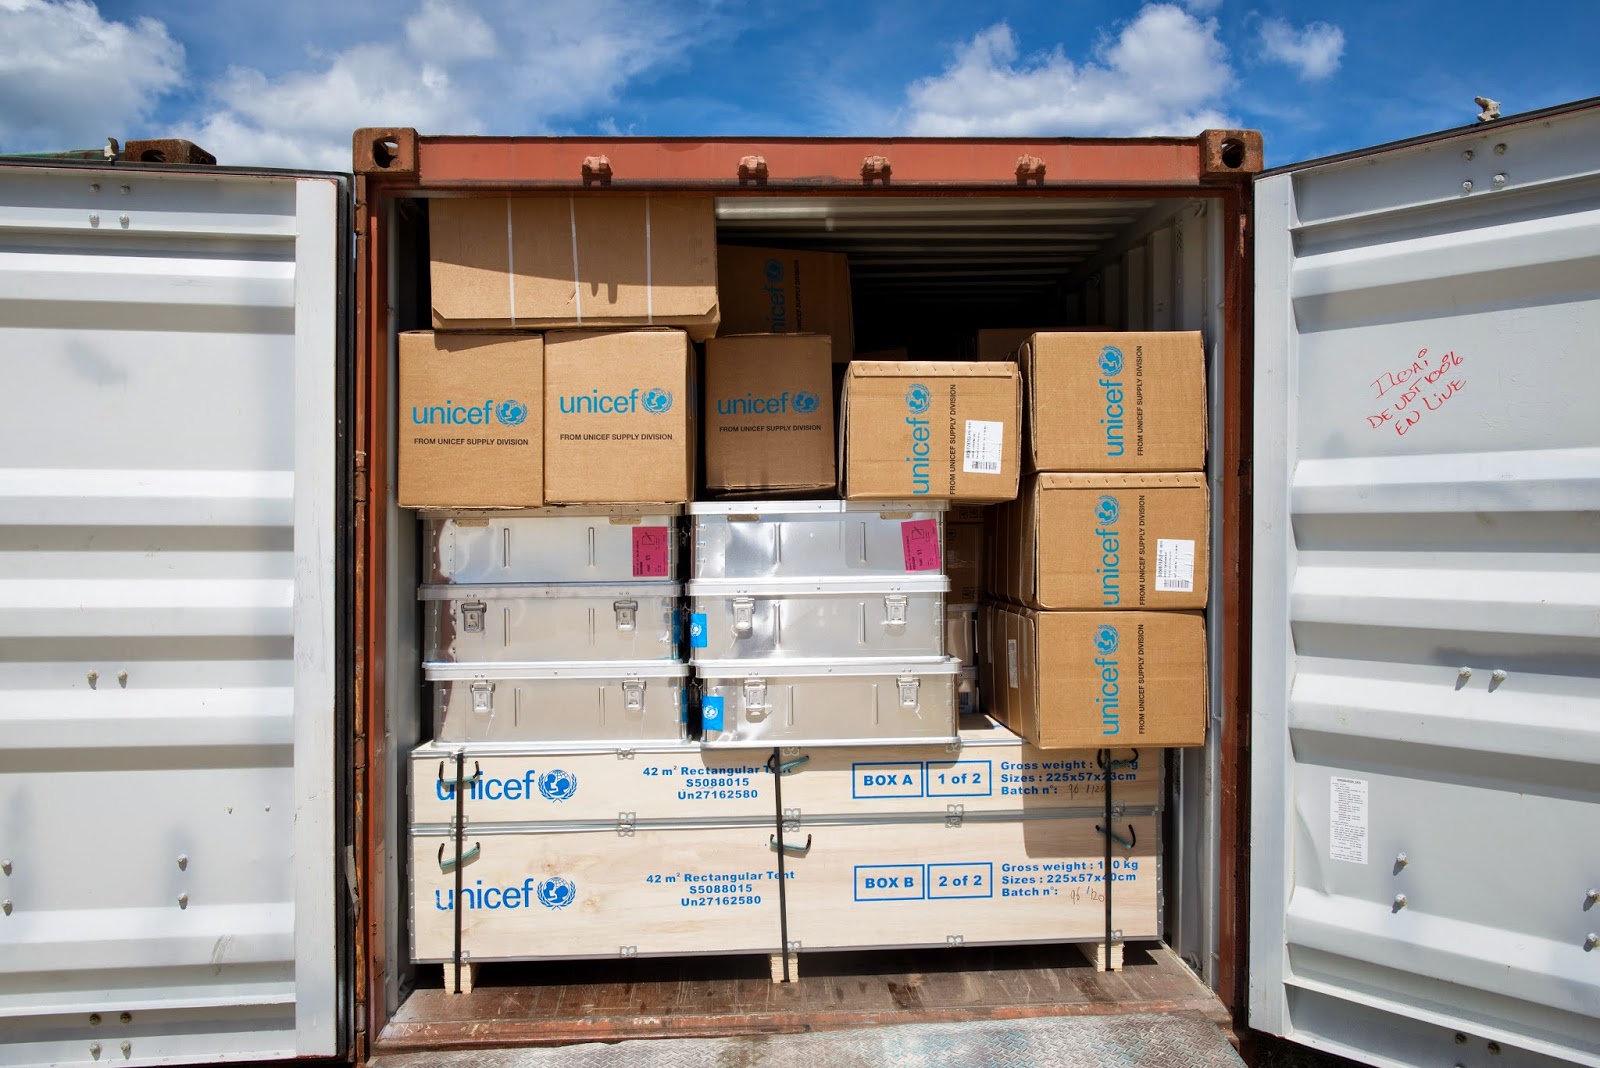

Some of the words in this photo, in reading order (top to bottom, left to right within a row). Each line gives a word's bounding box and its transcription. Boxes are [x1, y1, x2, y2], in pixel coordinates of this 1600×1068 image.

[764, 284, 785, 332] nicef
[560, 388, 639, 414] unicef
[717, 392, 789, 414] unicef
[412, 400, 493, 424] unicef
[1099, 379, 1124, 456] unicef
[496, 438, 528, 446] DIVISION
[906, 417, 930, 494] unicef
[1095, 528, 1120, 606] unicef
[1095, 658, 1120, 735] unicef
[643, 767, 658, 776] 42
[681, 765, 760, 776] Rectangular
[1001, 761, 1038, 770] Gross
[1042, 760, 1086, 771] weight
[686, 778, 750, 788] S5088015
[864, 774, 897, 786] BOX
[902, 774, 913, 785] A
[938, 774, 944, 784] 1
[951, 773, 967, 784] of
[972, 773, 981, 784] 2
[1001, 774, 1035, 782] Sizes
[678, 790, 758, 800] Un27162580
[1001, 785, 1038, 795] Batch
[1002, 863, 1039, 872] Gross
[1043, 862, 1086, 872] weight
[1098, 860, 1120, 870] 10
[1124, 860, 1138, 870] kg
[646, 874, 661, 883] 42
[684, 872, 763, 883] Rectangular
[865, 877, 898, 889] BOX
[904, 877, 914, 888] B
[939, 876, 948, 886] 2
[952, 875, 968, 886] of
[973, 875, 982, 886] 2
[1002, 876, 1036, 885] Sizes
[435, 878, 534, 910] unicef
[689, 884, 753, 894] S5088015
[1002, 888, 1039, 897] Batch
[681, 896, 761, 906] Un27162580
